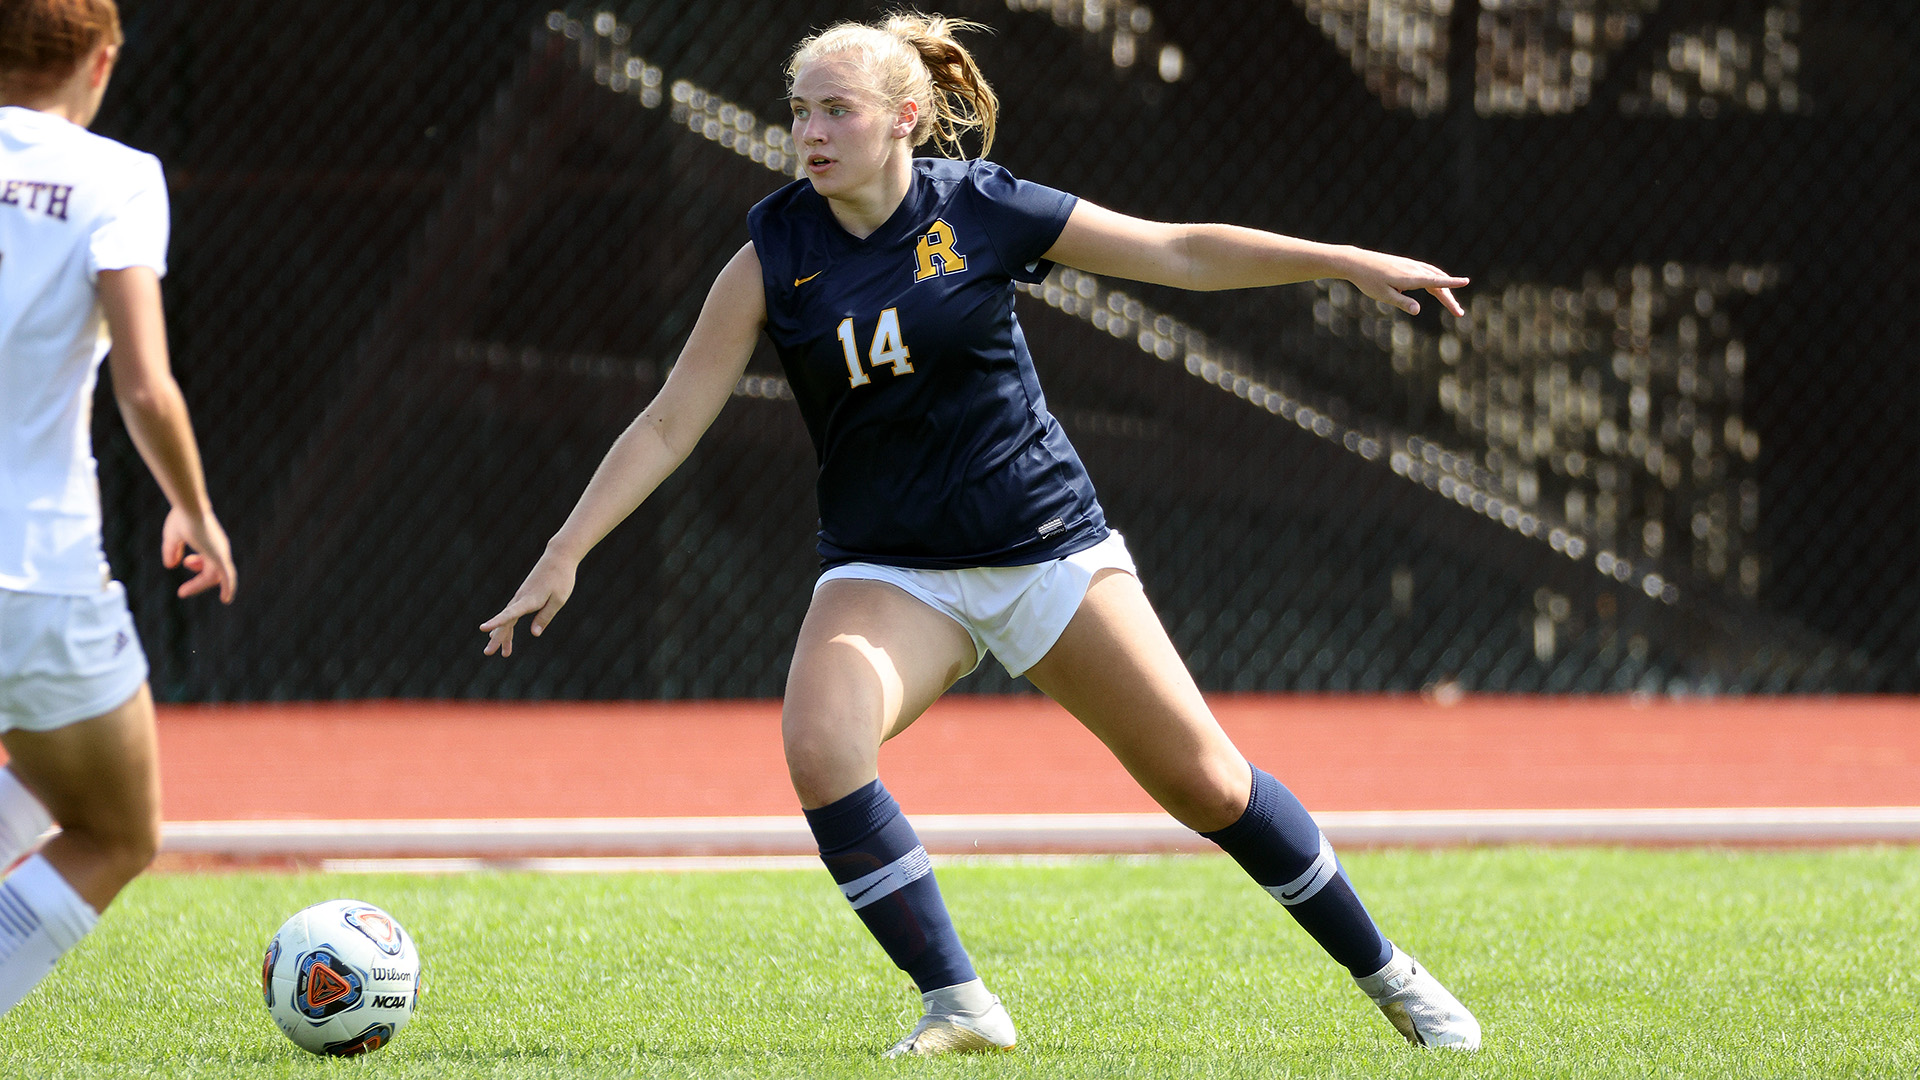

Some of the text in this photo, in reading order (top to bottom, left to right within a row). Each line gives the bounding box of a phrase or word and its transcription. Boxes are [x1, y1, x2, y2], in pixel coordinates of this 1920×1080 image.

[913, 217, 968, 283] R
[836, 307, 915, 389] 14
[371, 967, 411, 981] Wilson
[371, 995, 406, 1009] NCAA
